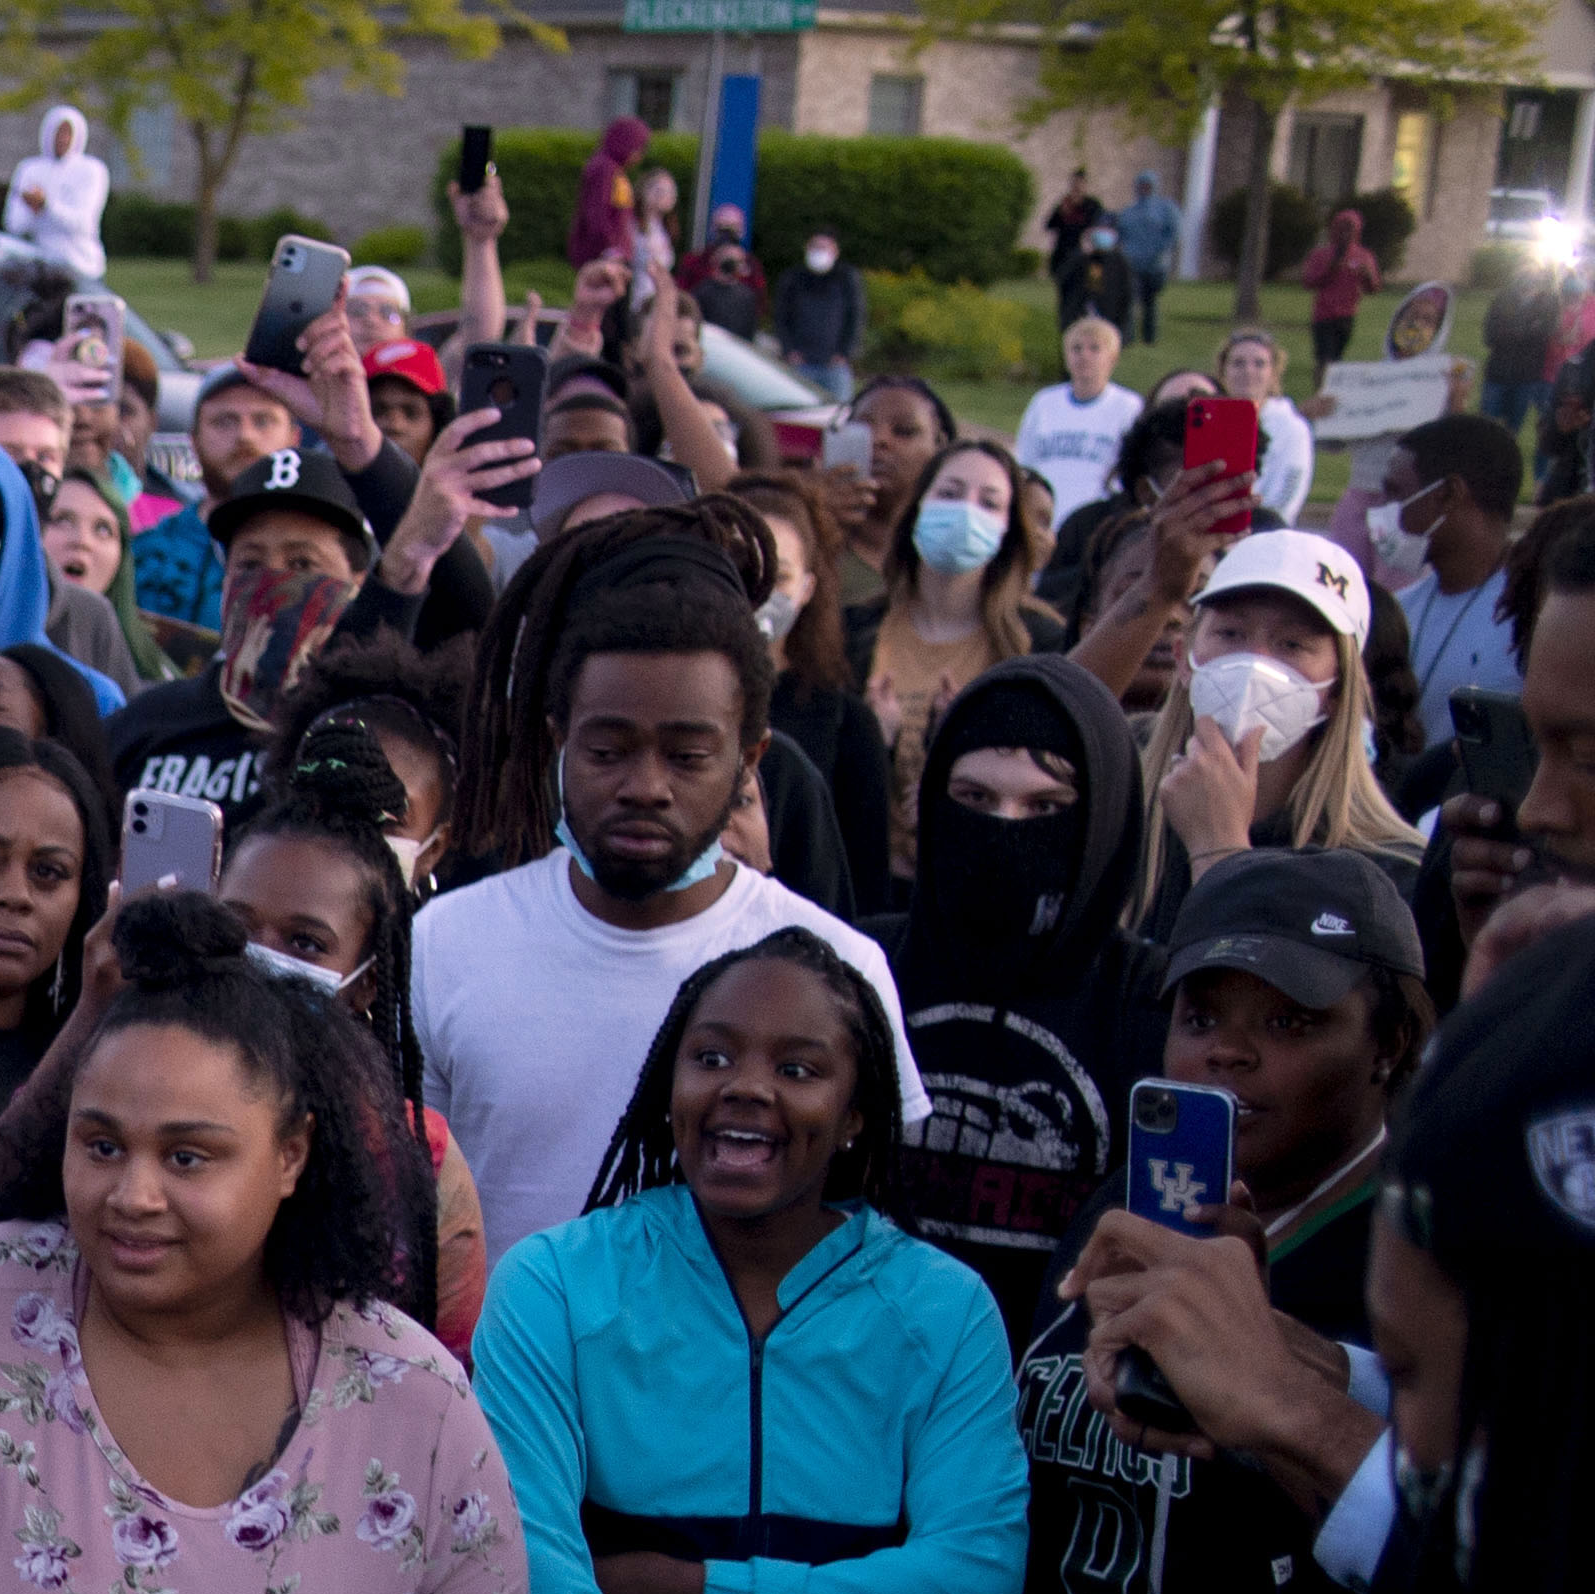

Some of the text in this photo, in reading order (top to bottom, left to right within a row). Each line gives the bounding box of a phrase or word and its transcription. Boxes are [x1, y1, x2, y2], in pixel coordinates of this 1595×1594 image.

[264, 449, 302, 490] B
[1315, 561, 1349, 601] M
[1319, 911, 1349, 931] NIKE
[1147, 1157, 1207, 1212] UK
